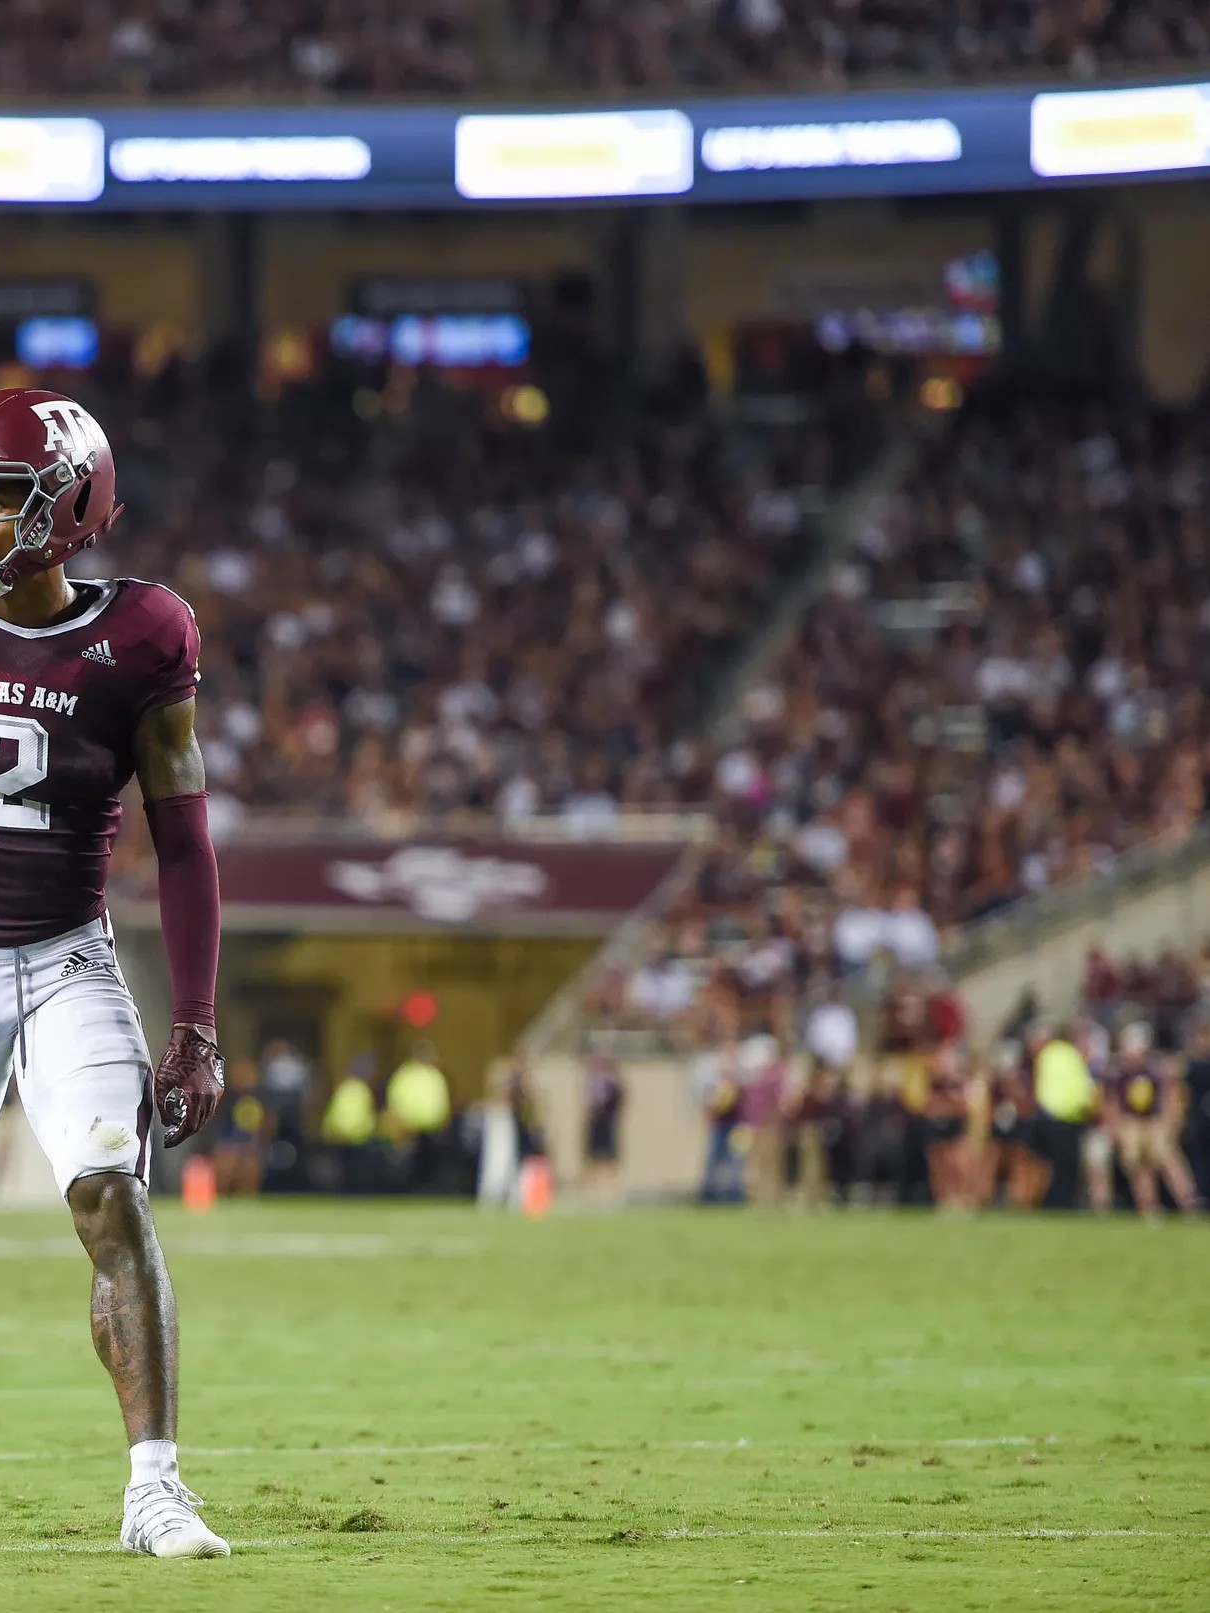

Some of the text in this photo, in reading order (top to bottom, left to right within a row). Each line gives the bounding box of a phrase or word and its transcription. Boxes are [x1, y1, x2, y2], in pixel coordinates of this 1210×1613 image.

[81, 649, 117, 667] adidas
[30, 686, 79, 716] A&M
[61, 960, 100, 977] adidas
